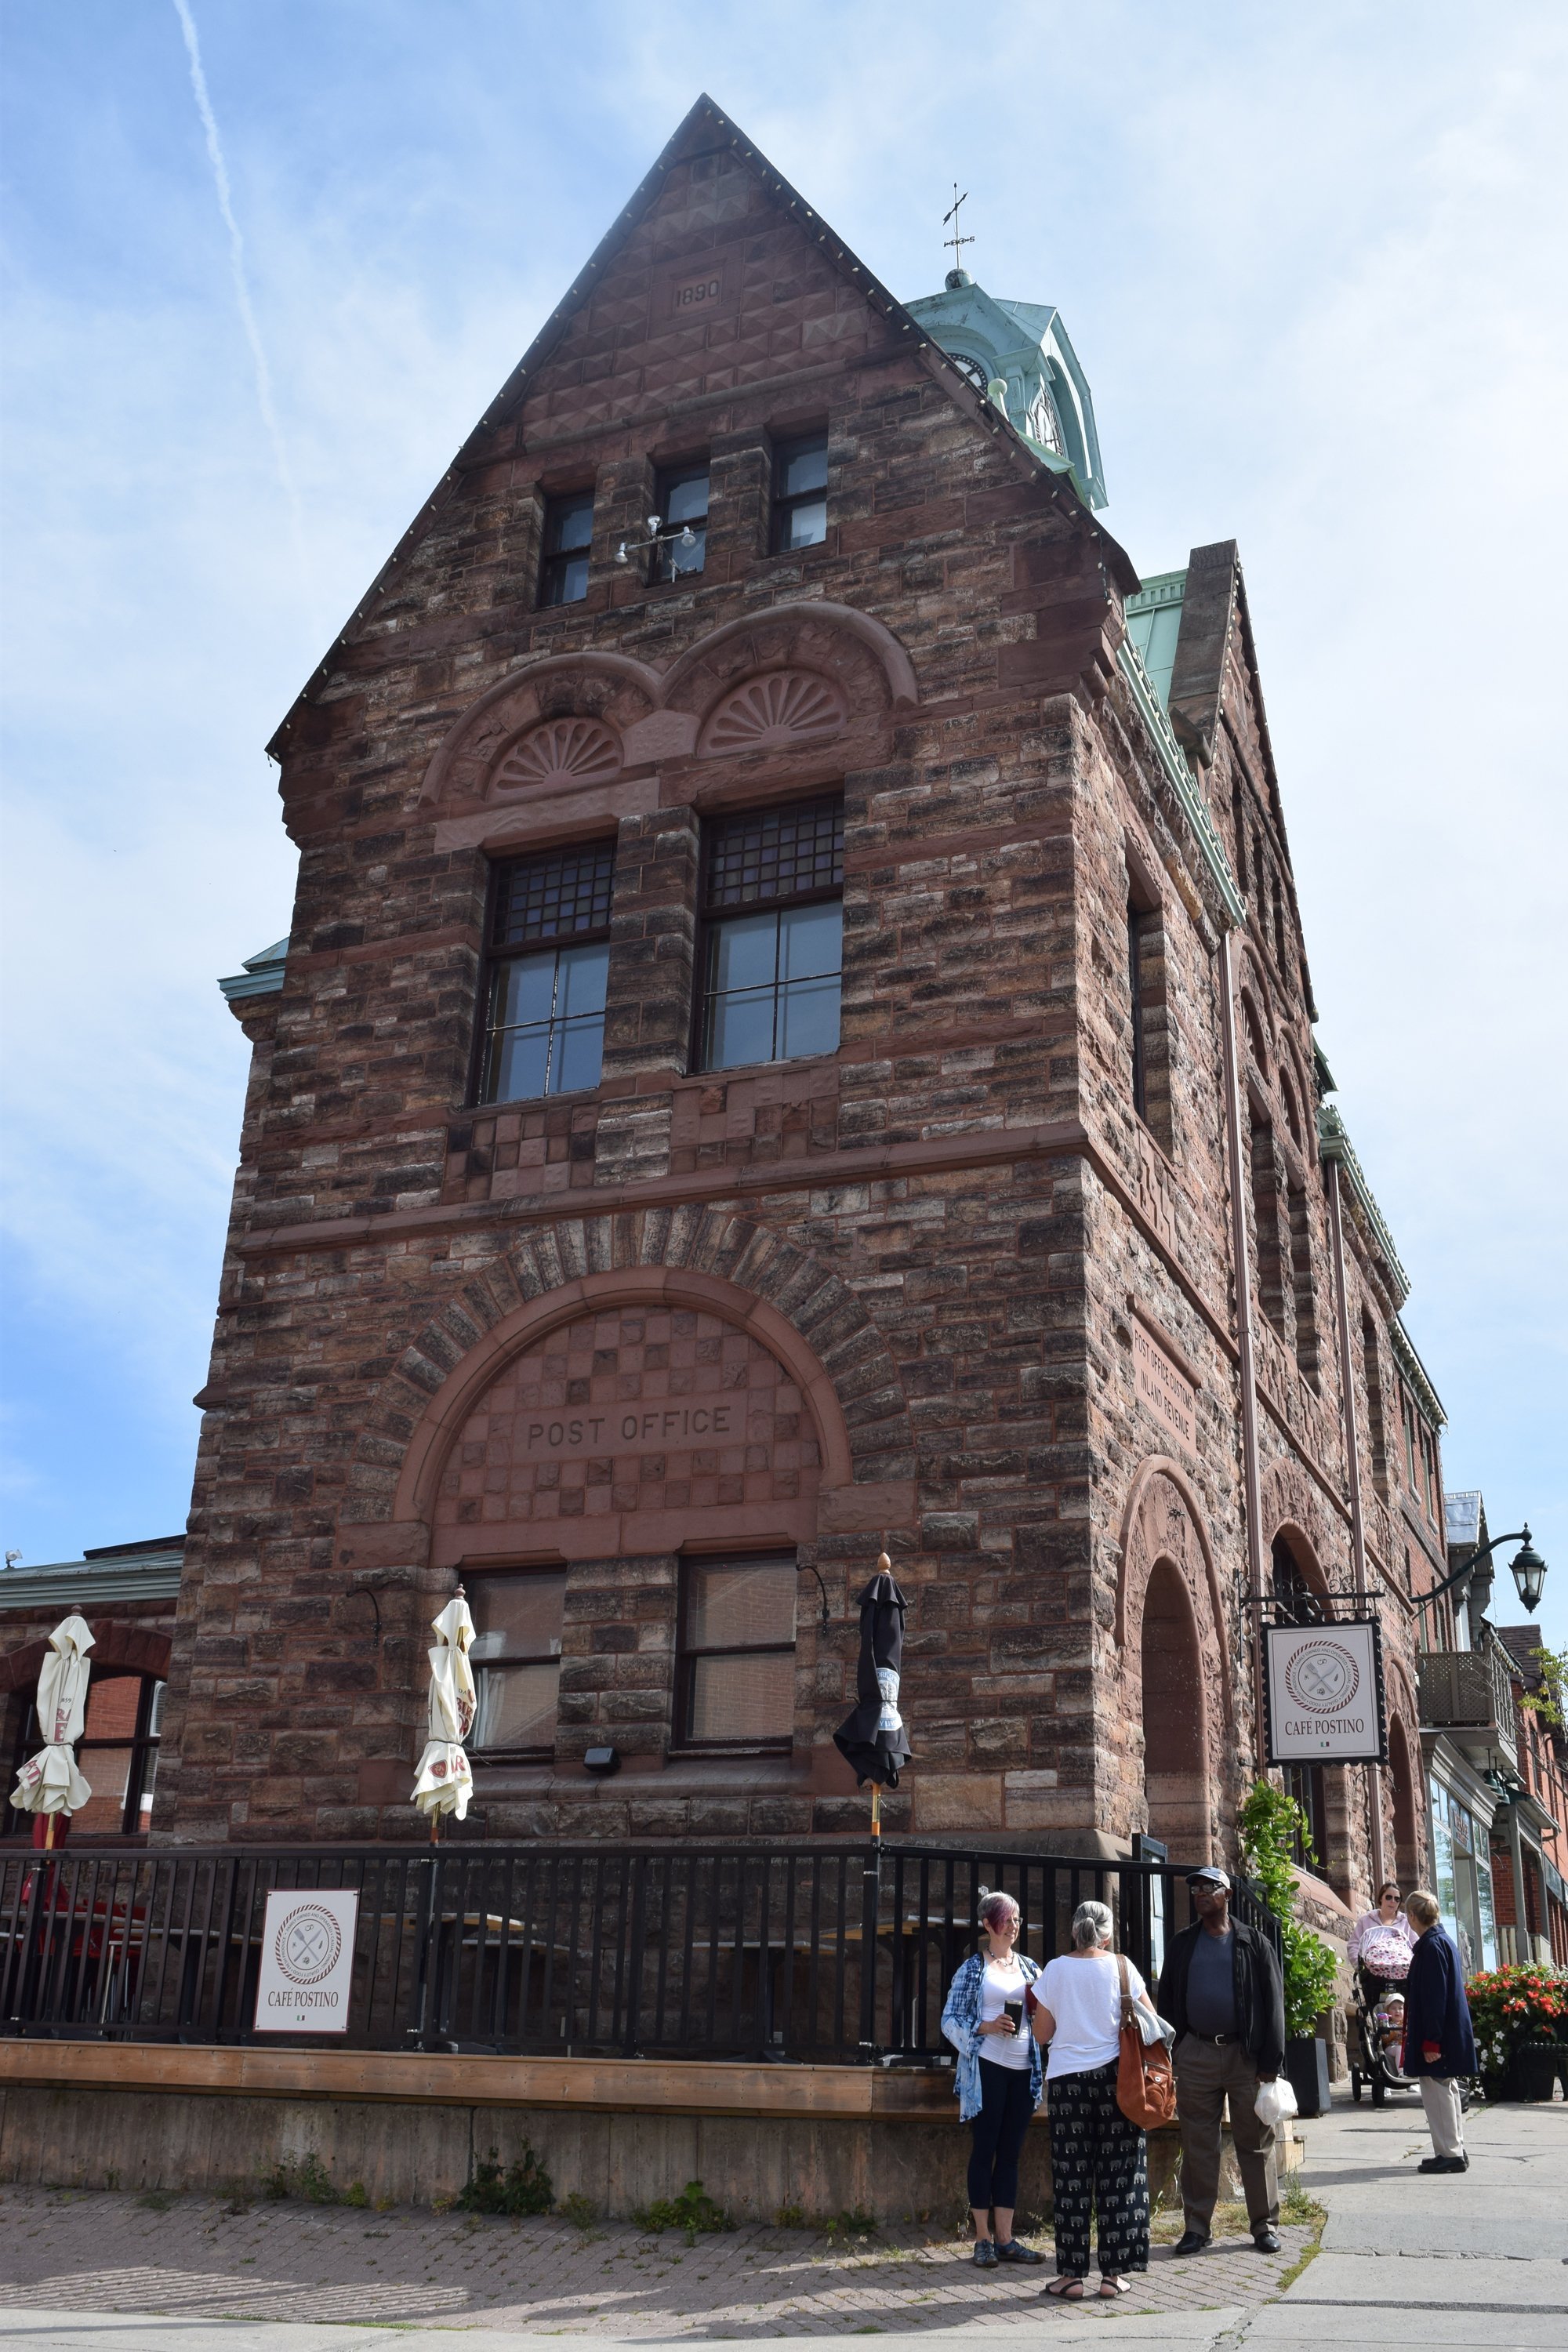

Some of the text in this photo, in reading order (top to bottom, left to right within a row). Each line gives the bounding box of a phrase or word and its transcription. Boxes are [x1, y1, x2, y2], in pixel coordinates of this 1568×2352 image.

[676, 281, 720, 307] 1890
[1134, 1329, 1193, 1413] POST OFFICE CUSTOMS
[1140, 1368, 1190, 1441] INLAND REVENUE
[528, 1406, 731, 1450] POST OFFICE
[1305, 1648, 1321, 1657] OWNED
[1285, 1717, 1364, 1736] CAFÉ POSTINO
[268, 1988, 339, 2007] CAFÉ POSTINO
